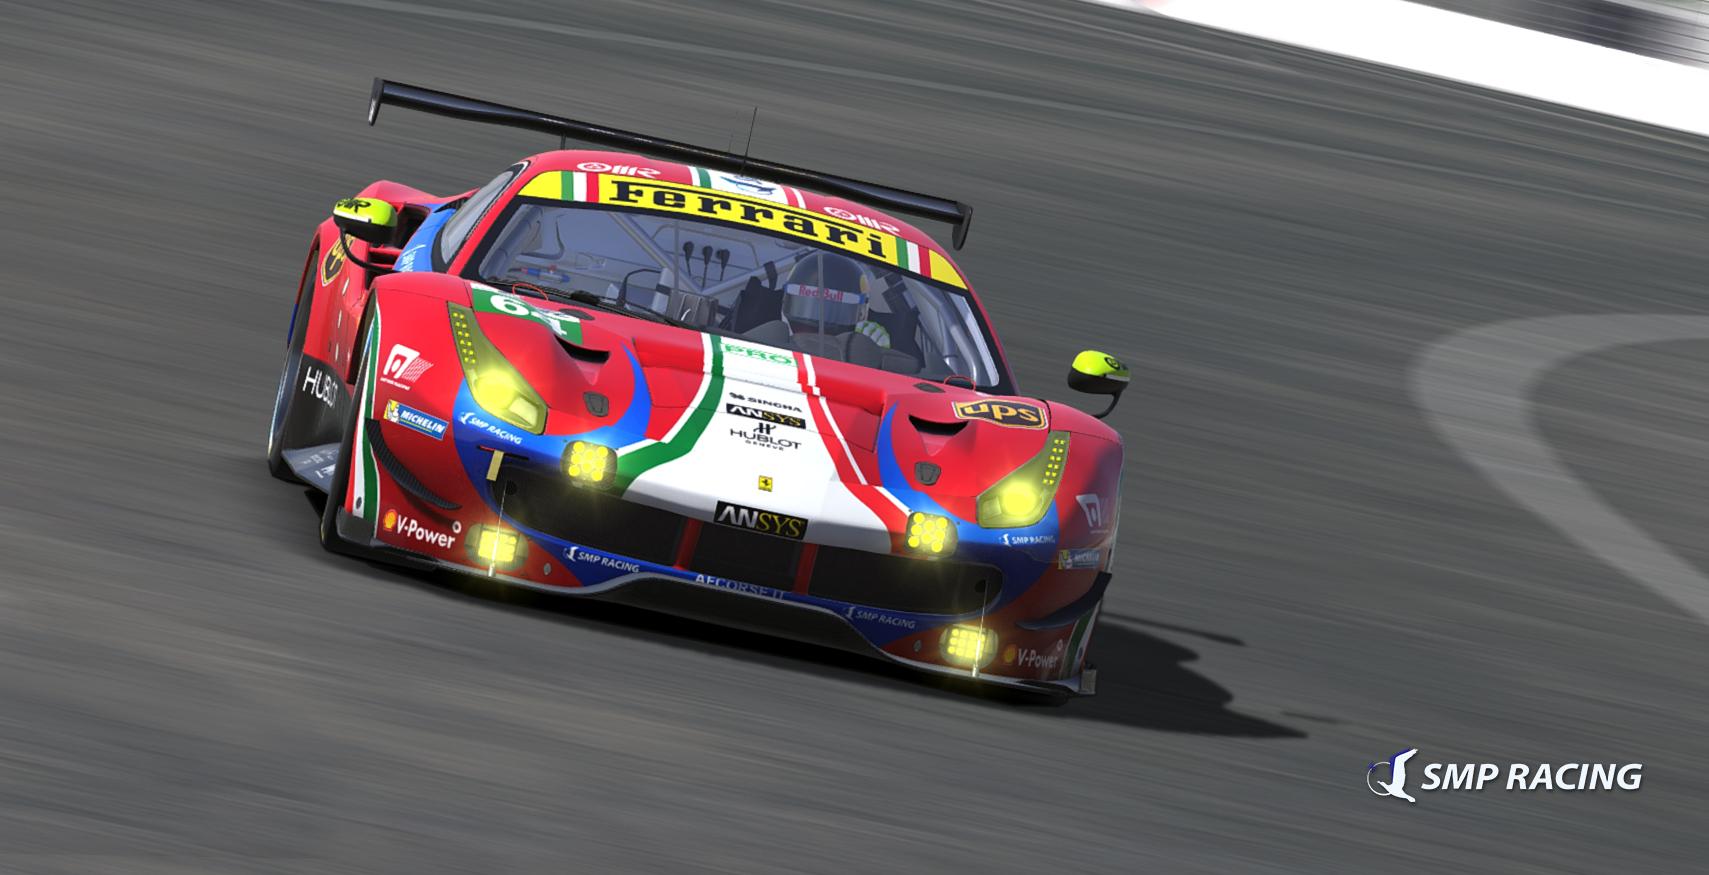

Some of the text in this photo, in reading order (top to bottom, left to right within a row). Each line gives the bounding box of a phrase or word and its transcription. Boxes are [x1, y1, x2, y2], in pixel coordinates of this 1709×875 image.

[609, 180, 887, 259] Ferrari
[400, 410, 446, 434] MICHELIN
[730, 406, 801, 426] ANSYS
[964, 404, 1040, 422] ups
[469, 417, 523, 444] SMP RACING
[730, 428, 801, 449] HUBLOT
[397, 514, 455, 549] V-Power
[717, 505, 802, 538] ANSYS
[577, 551, 640, 573] SMP RACING
[855, 610, 917, 629] SMP RACING
[1018, 648, 1059, 669] V-Power
